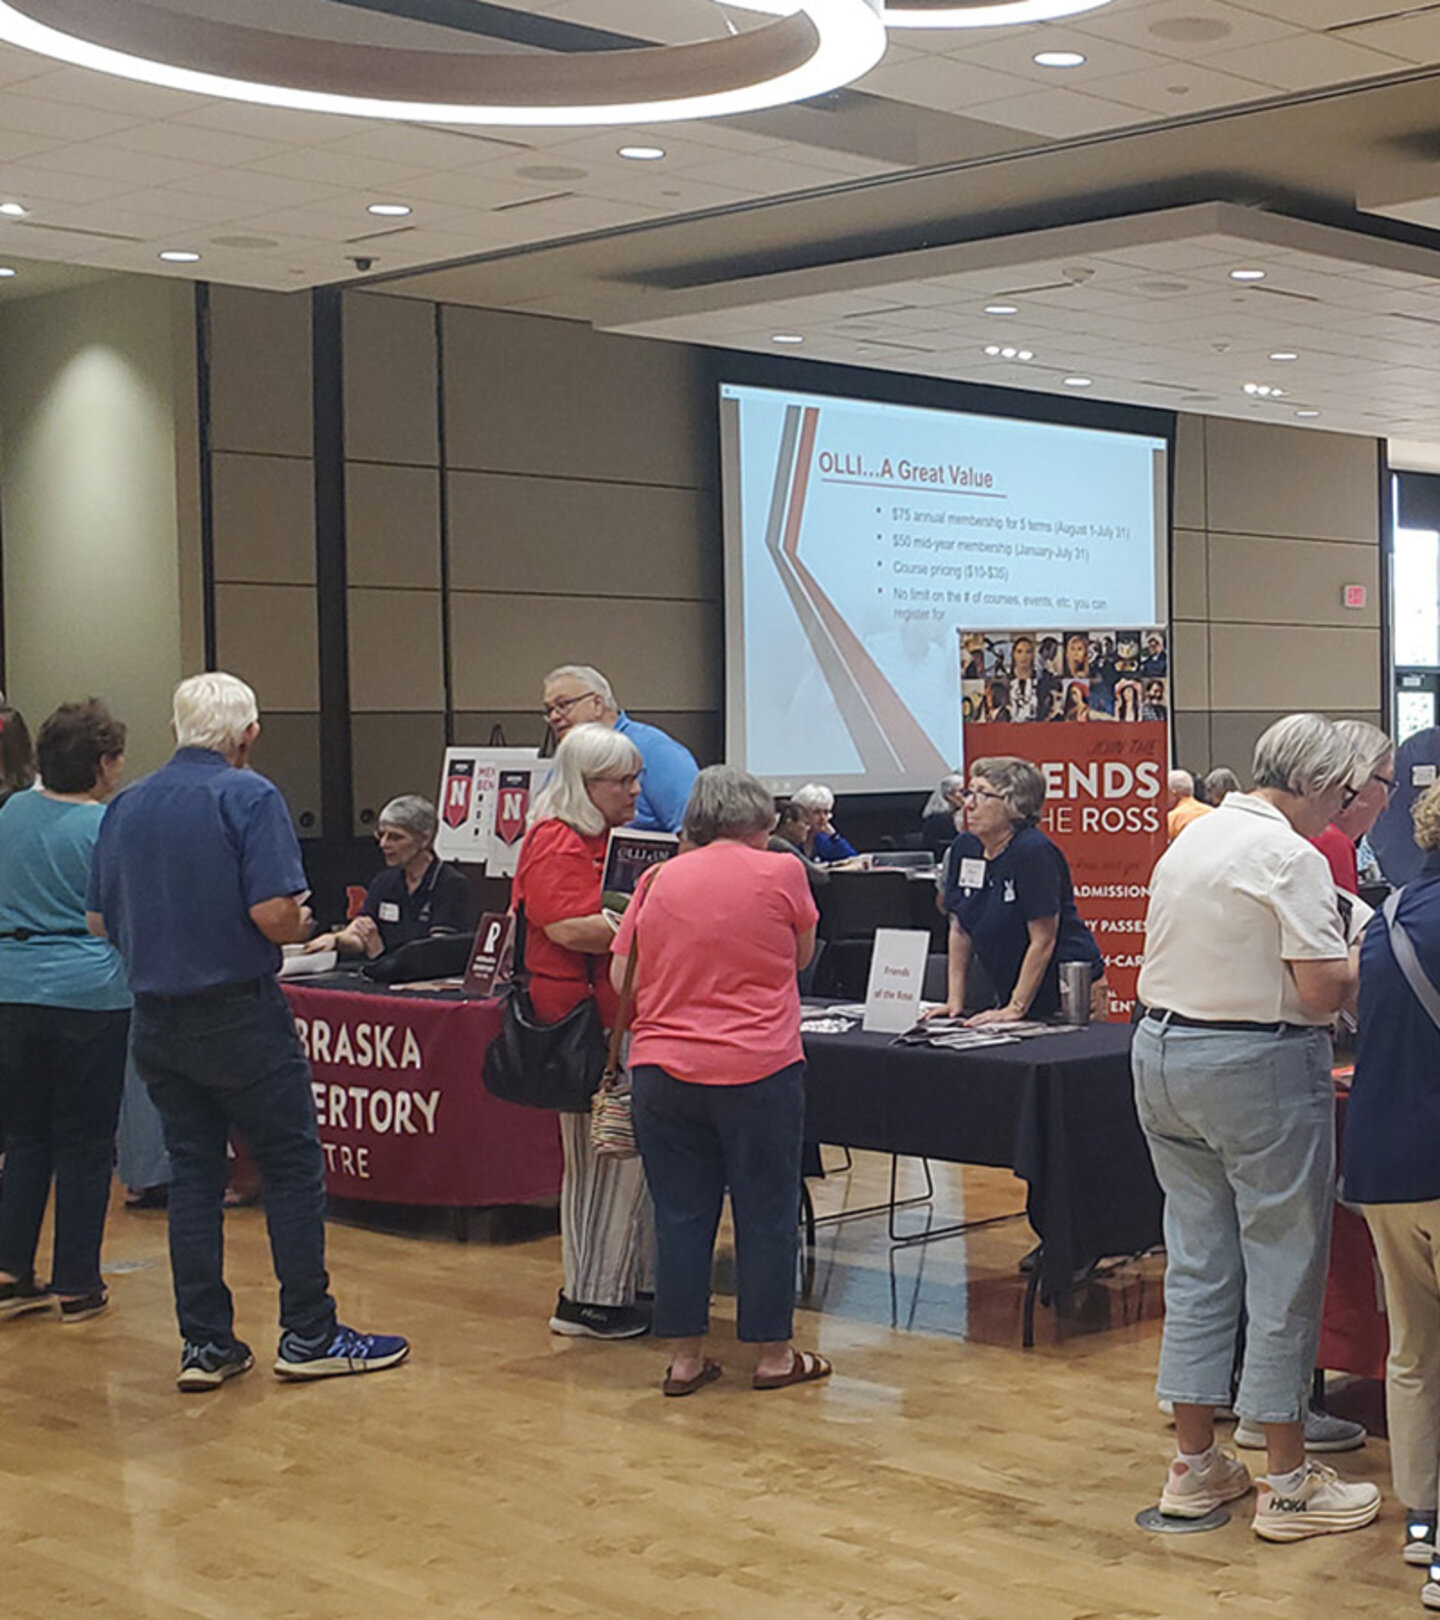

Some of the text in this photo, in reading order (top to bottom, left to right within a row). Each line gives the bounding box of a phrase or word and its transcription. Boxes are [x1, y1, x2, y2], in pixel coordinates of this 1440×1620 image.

[898, 460, 944, 484] Great
[949, 464, 993, 488] Value
[892, 507, 911, 521] $75
[913, 510, 945, 525] annual
[948, 513, 1004, 530] membership
[1006, 516, 1018, 530] for
[1028, 519, 1053, 533] terms
[893, 533, 911, 547] $50
[913, 537, 955, 552] mid-year
[957, 540, 1012, 556] membership
[893, 560, 928, 575] Course
[930, 564, 961, 580] pricing
[894, 587, 908, 601] No
[911, 588, 930, 601] limit
[932, 591, 944, 602] on
[946, 590, 962, 603] the
[894, 607, 945, 622] register for
[449, 779, 468, 807] N
[1043, 761, 1161, 799] ENDS
[502, 792, 523, 820] N
[1082, 806, 1160, 833] ROSS
[311, 1081, 441, 1134] ERTORY
[1269, 1497, 1307, 1512] HOKA
